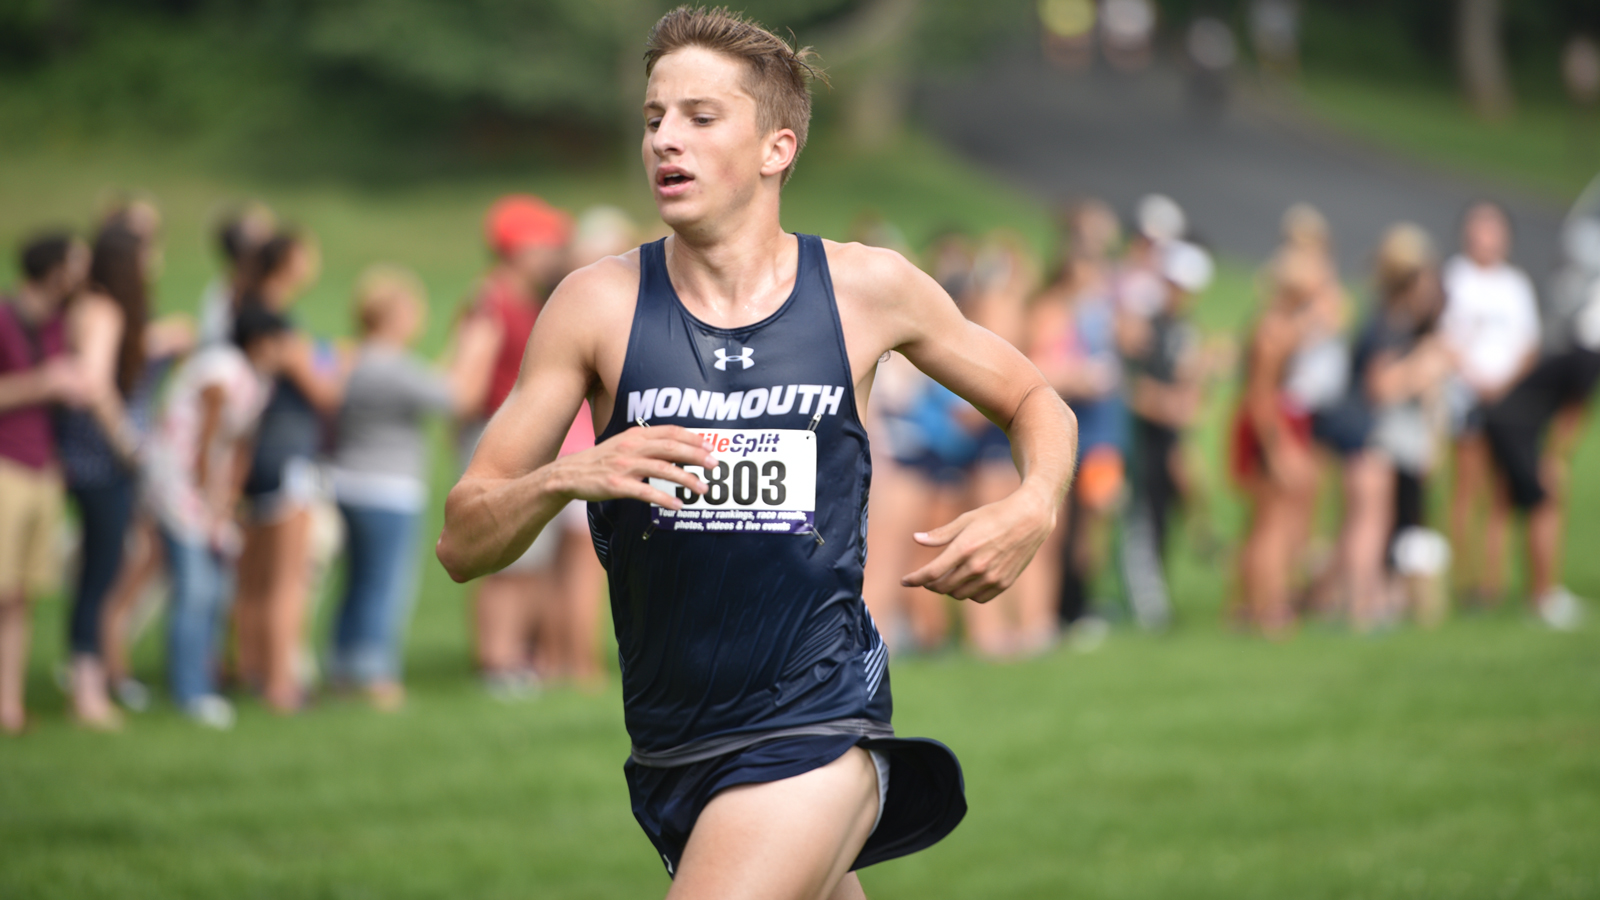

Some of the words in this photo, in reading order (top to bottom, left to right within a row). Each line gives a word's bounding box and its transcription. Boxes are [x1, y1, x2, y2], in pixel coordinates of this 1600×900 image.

[627, 385, 844, 423] MONMOUTH
[698, 433, 780, 457] ileSplit
[659, 508, 676, 518] Your
[677, 510, 700, 519] home
[701, 510, 715, 519] for
[715, 510, 755, 521] rankings,
[756, 511, 777, 519] race
[674, 520, 704, 531] photos,
[706, 521, 734, 530] videos
[735, 521, 743, 530] &
[744, 521, 761, 531] live
[762, 522, 791, 531] events
